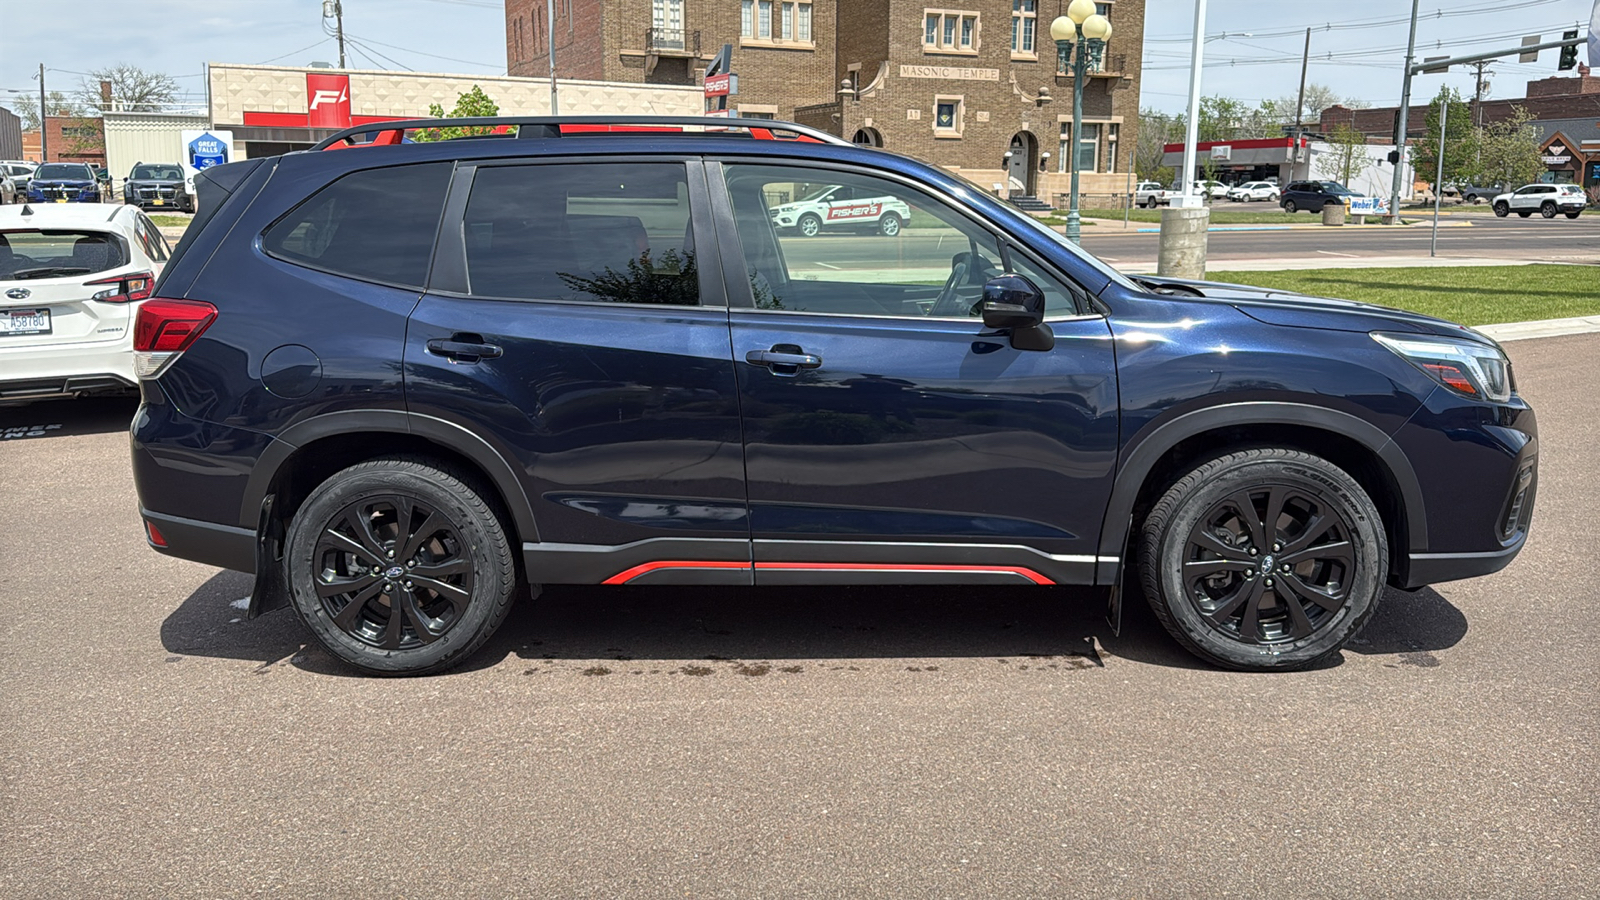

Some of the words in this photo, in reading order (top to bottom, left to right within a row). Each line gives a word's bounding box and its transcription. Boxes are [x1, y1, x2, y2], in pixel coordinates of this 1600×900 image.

[902, 66, 950, 78] MASONIC
[957, 68, 998, 79] TEMPLE
[1351, 199, 1372, 209] Weber
[831, 205, 878, 218] FISHER'S
